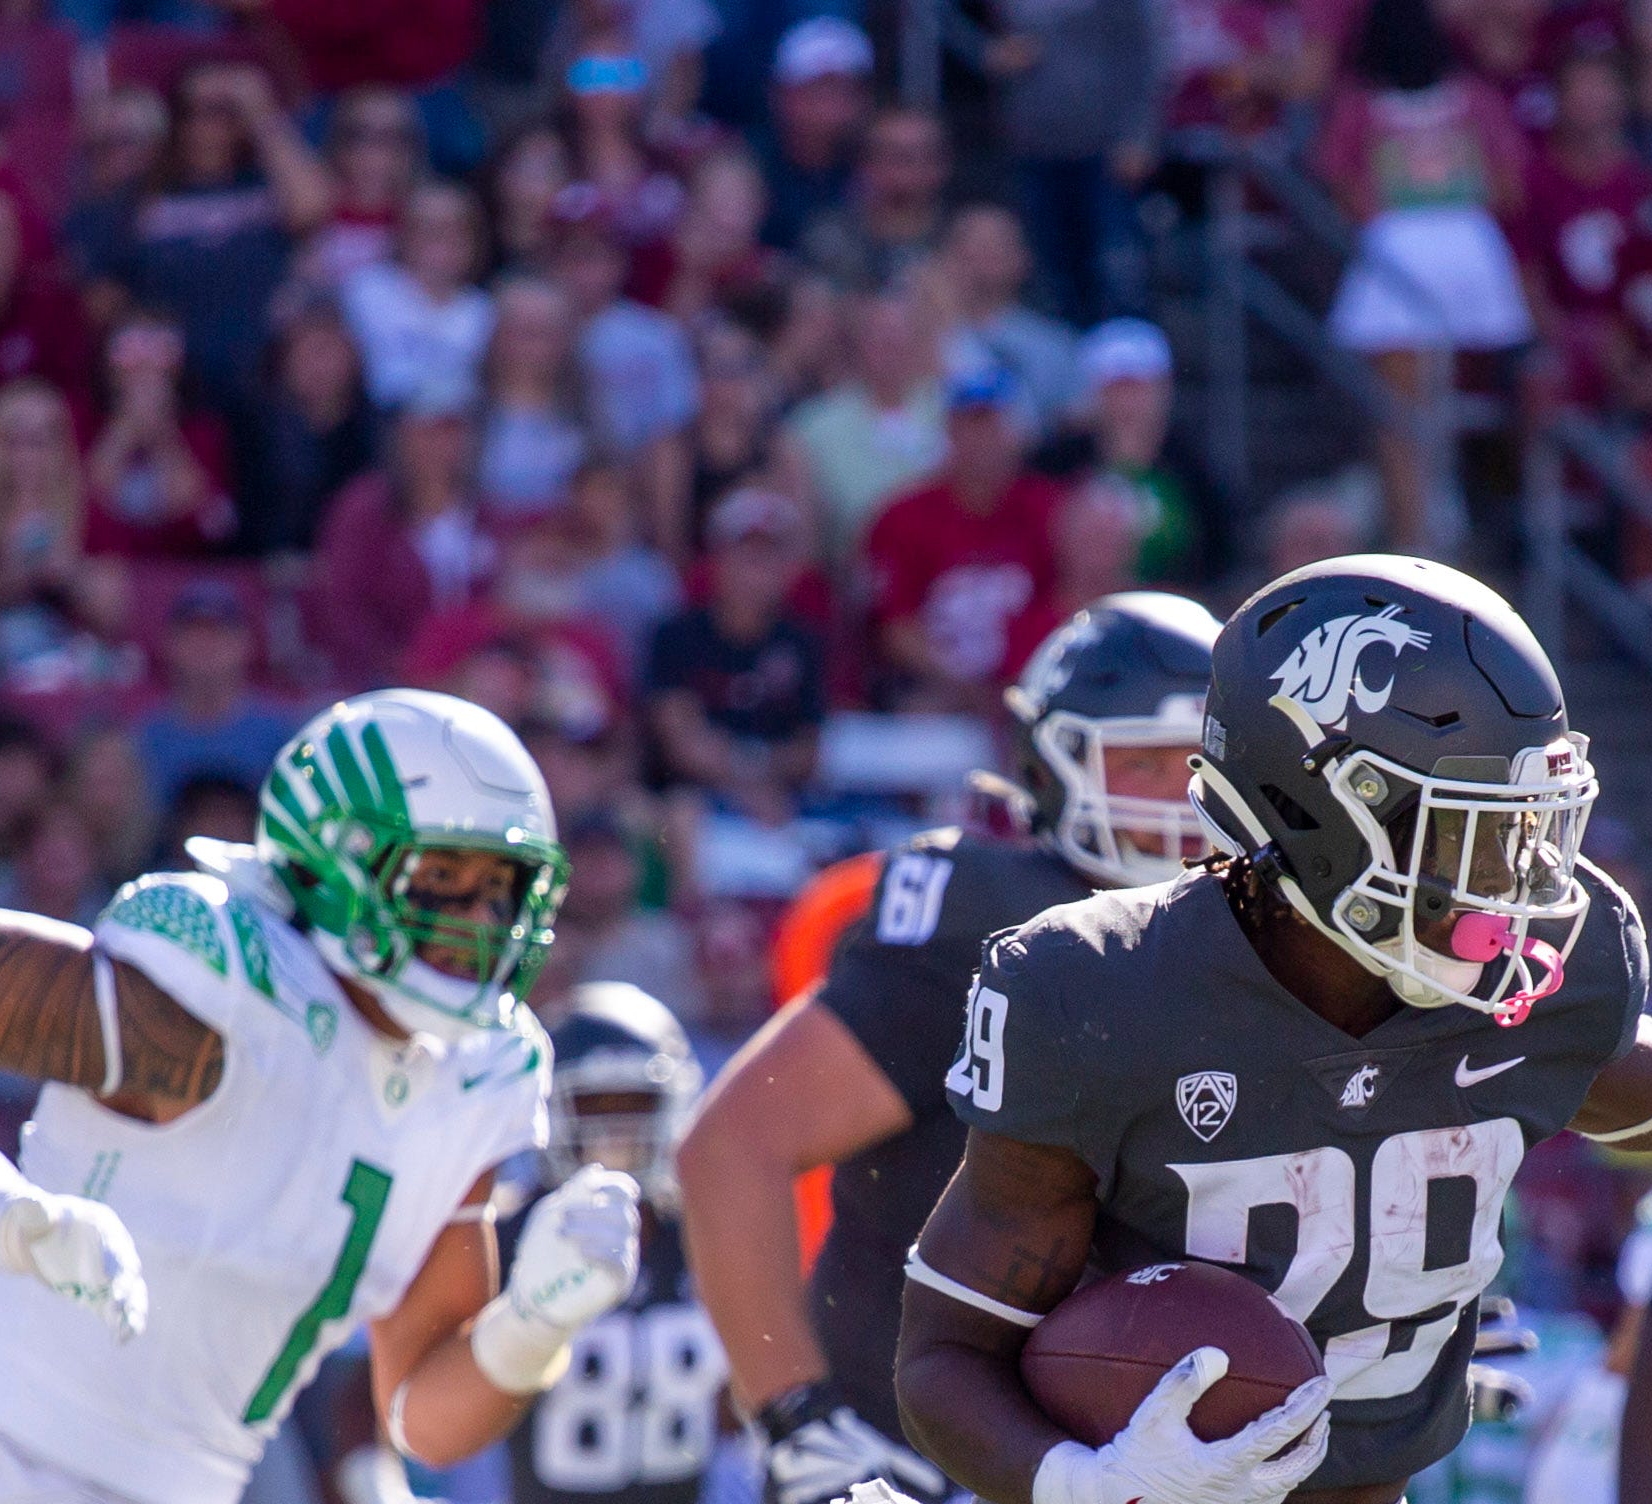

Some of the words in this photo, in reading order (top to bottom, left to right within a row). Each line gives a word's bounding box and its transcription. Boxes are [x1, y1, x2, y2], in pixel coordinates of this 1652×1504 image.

[1178, 1074, 1234, 1114] PAC
[1192, 1101, 1221, 1127] 12
[242, 1160, 393, 1427] 1
[1164, 1117, 1527, 1400] 29
[533, 1308, 729, 1491] 88
